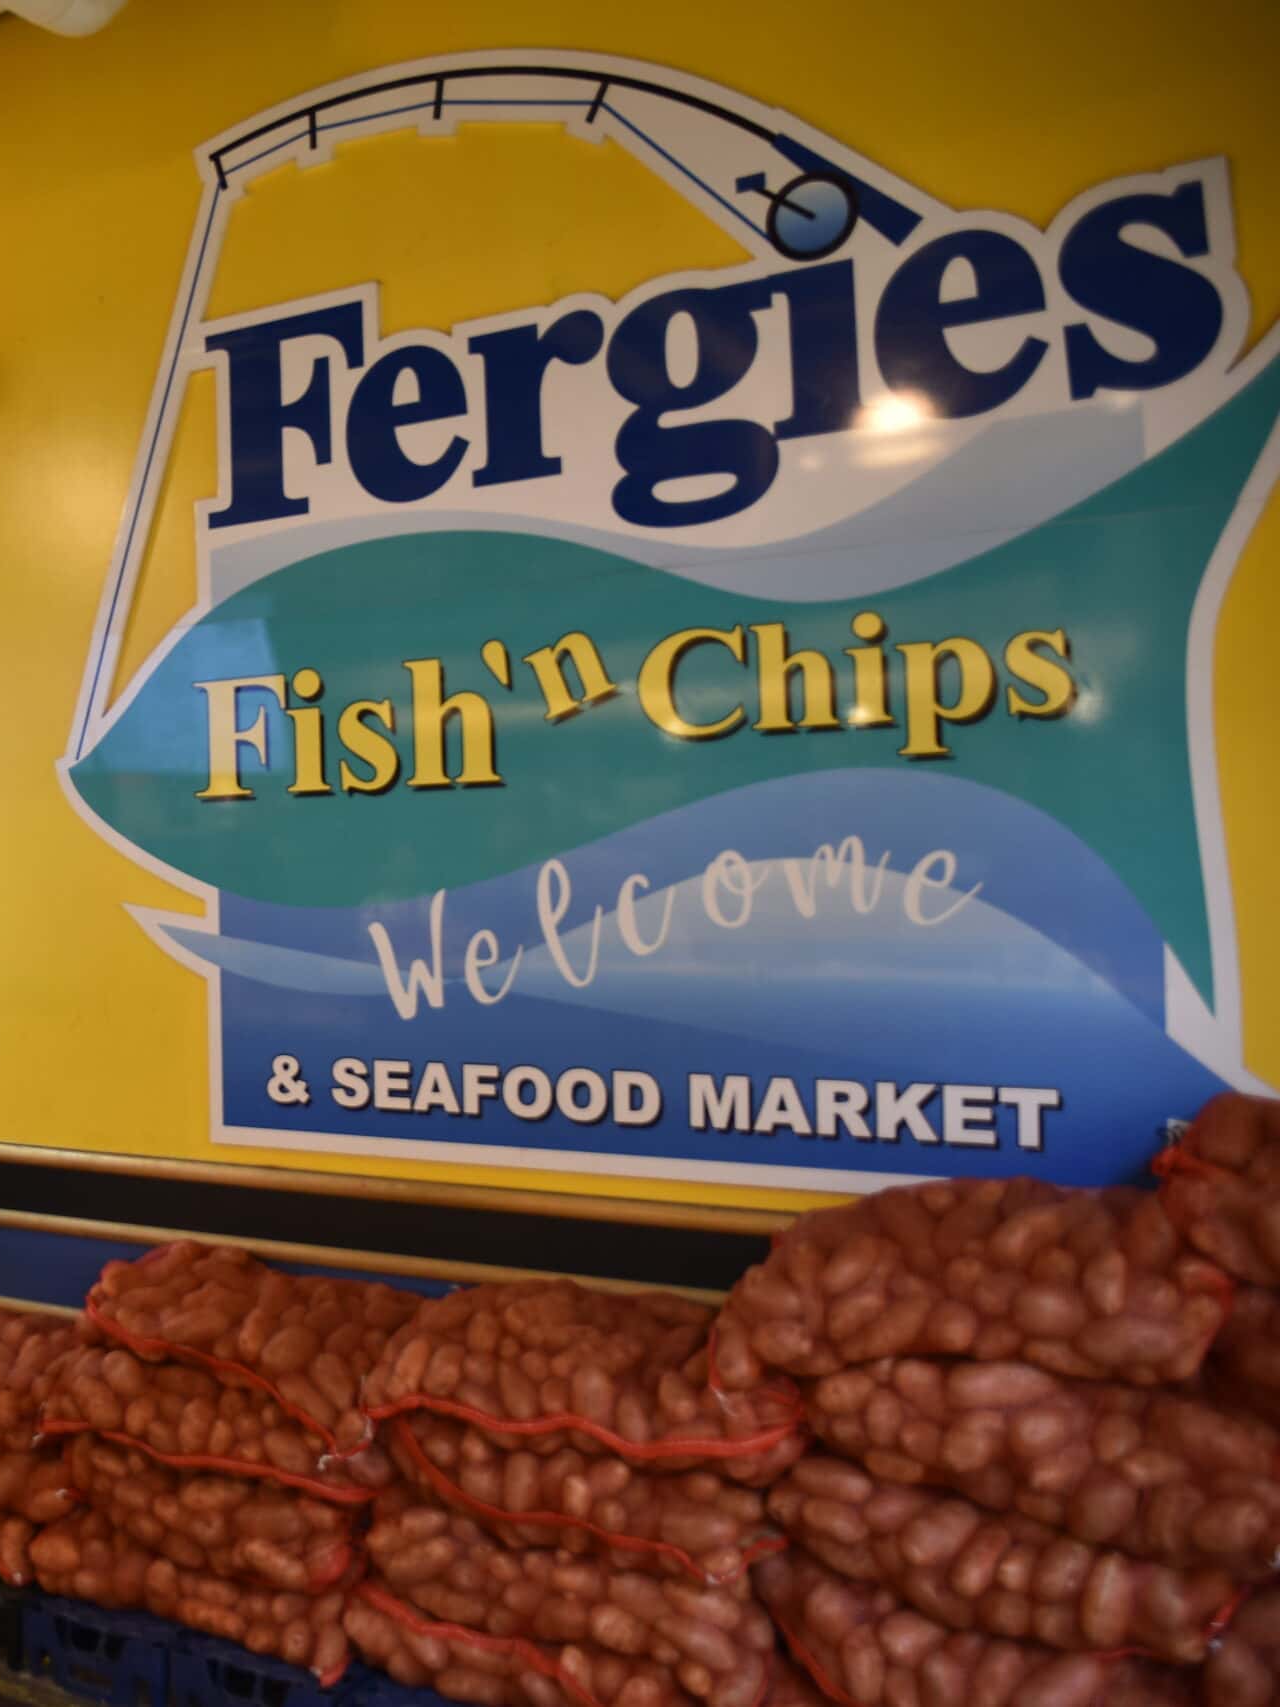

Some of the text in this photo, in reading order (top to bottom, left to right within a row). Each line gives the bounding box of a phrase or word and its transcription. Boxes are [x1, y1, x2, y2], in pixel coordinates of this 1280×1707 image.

[205, 172, 1226, 530] Fergies
[637, 611, 1079, 759] Chips
[368, 835, 983, 1020] Welcome
[266, 1055, 1061, 1152] & SEAFOOD MARKET
